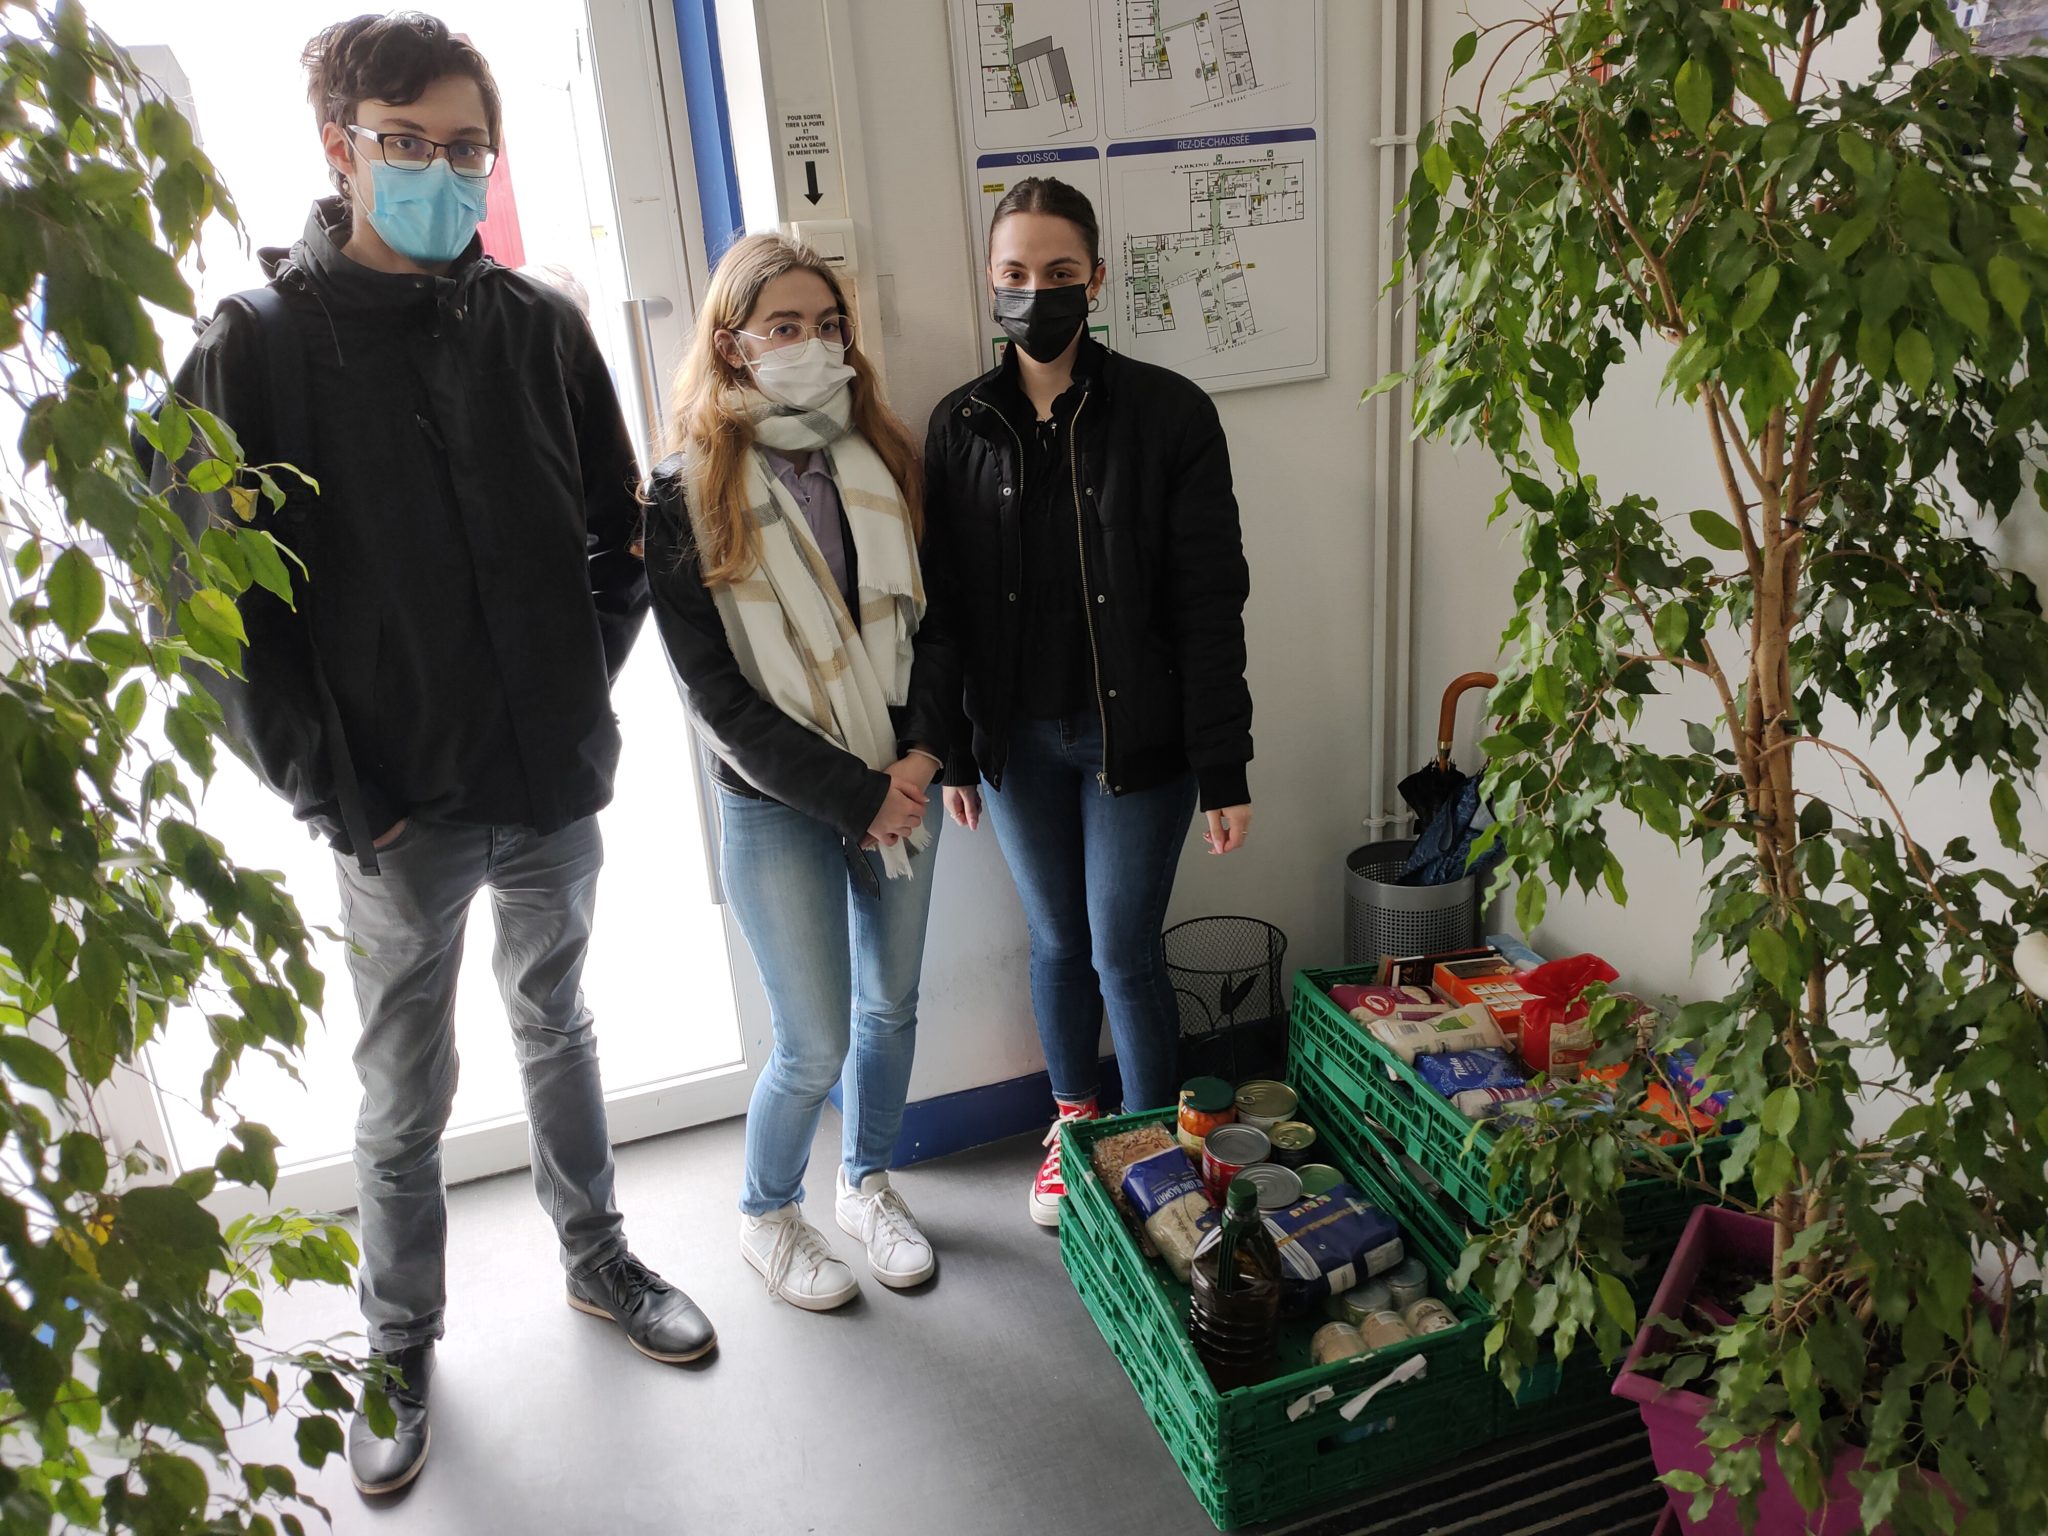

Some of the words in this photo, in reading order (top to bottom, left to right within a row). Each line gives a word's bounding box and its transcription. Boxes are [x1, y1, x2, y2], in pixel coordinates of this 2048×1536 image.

[1177, 133, 1250, 150] REZ-DE-CHAUSSÉE
[1016, 151, 1061, 165] SOUS-SOL
[1449, 1057, 1469, 1080] Tilda
[1155, 1186, 1182, 1206] BASMATI
